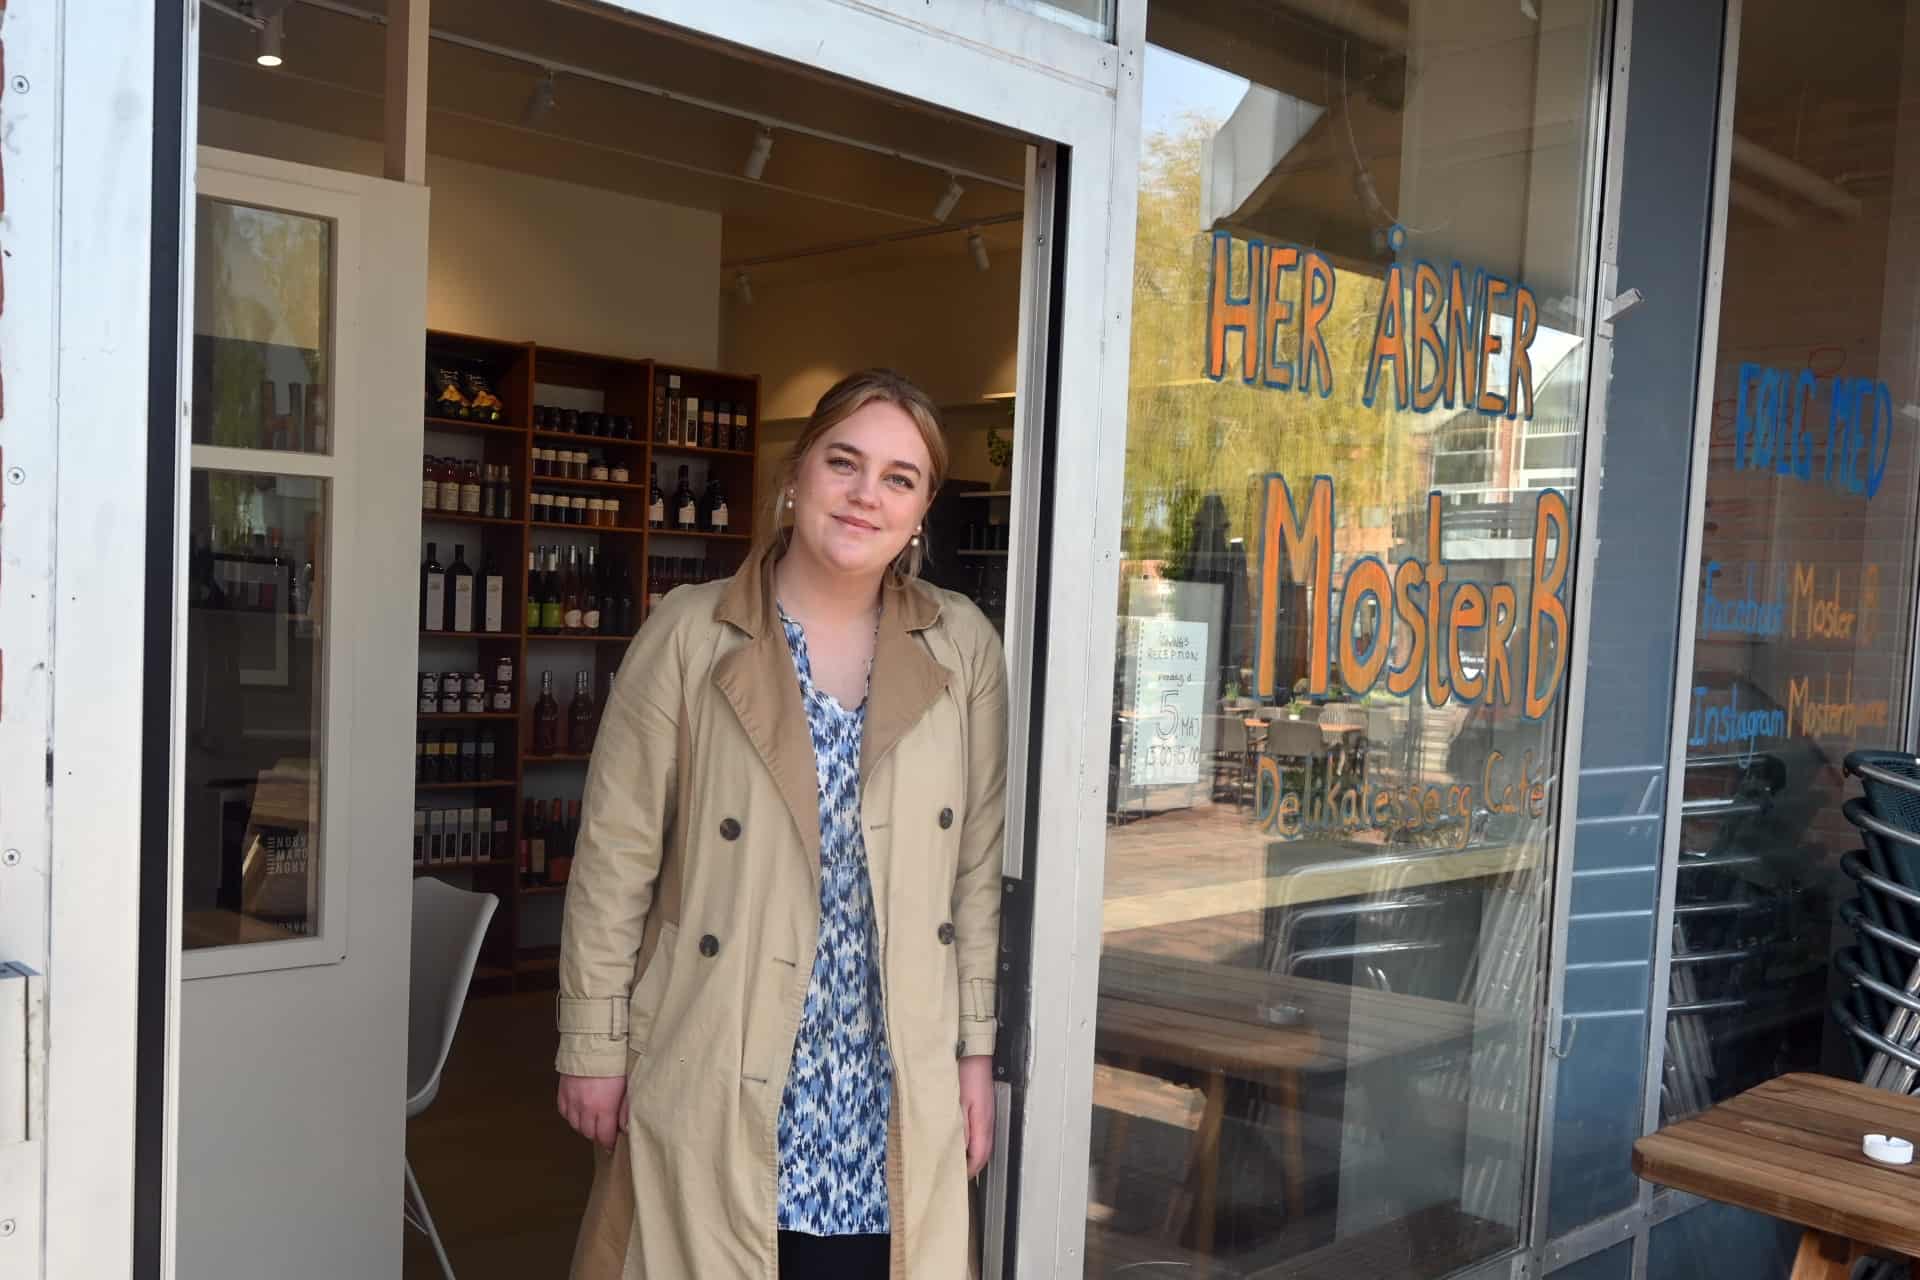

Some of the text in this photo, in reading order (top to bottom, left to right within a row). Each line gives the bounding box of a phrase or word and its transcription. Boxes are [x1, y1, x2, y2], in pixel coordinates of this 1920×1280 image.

[1206, 224, 1540, 420] HER ÅBNER
[1824, 375, 1893, 498] MED
